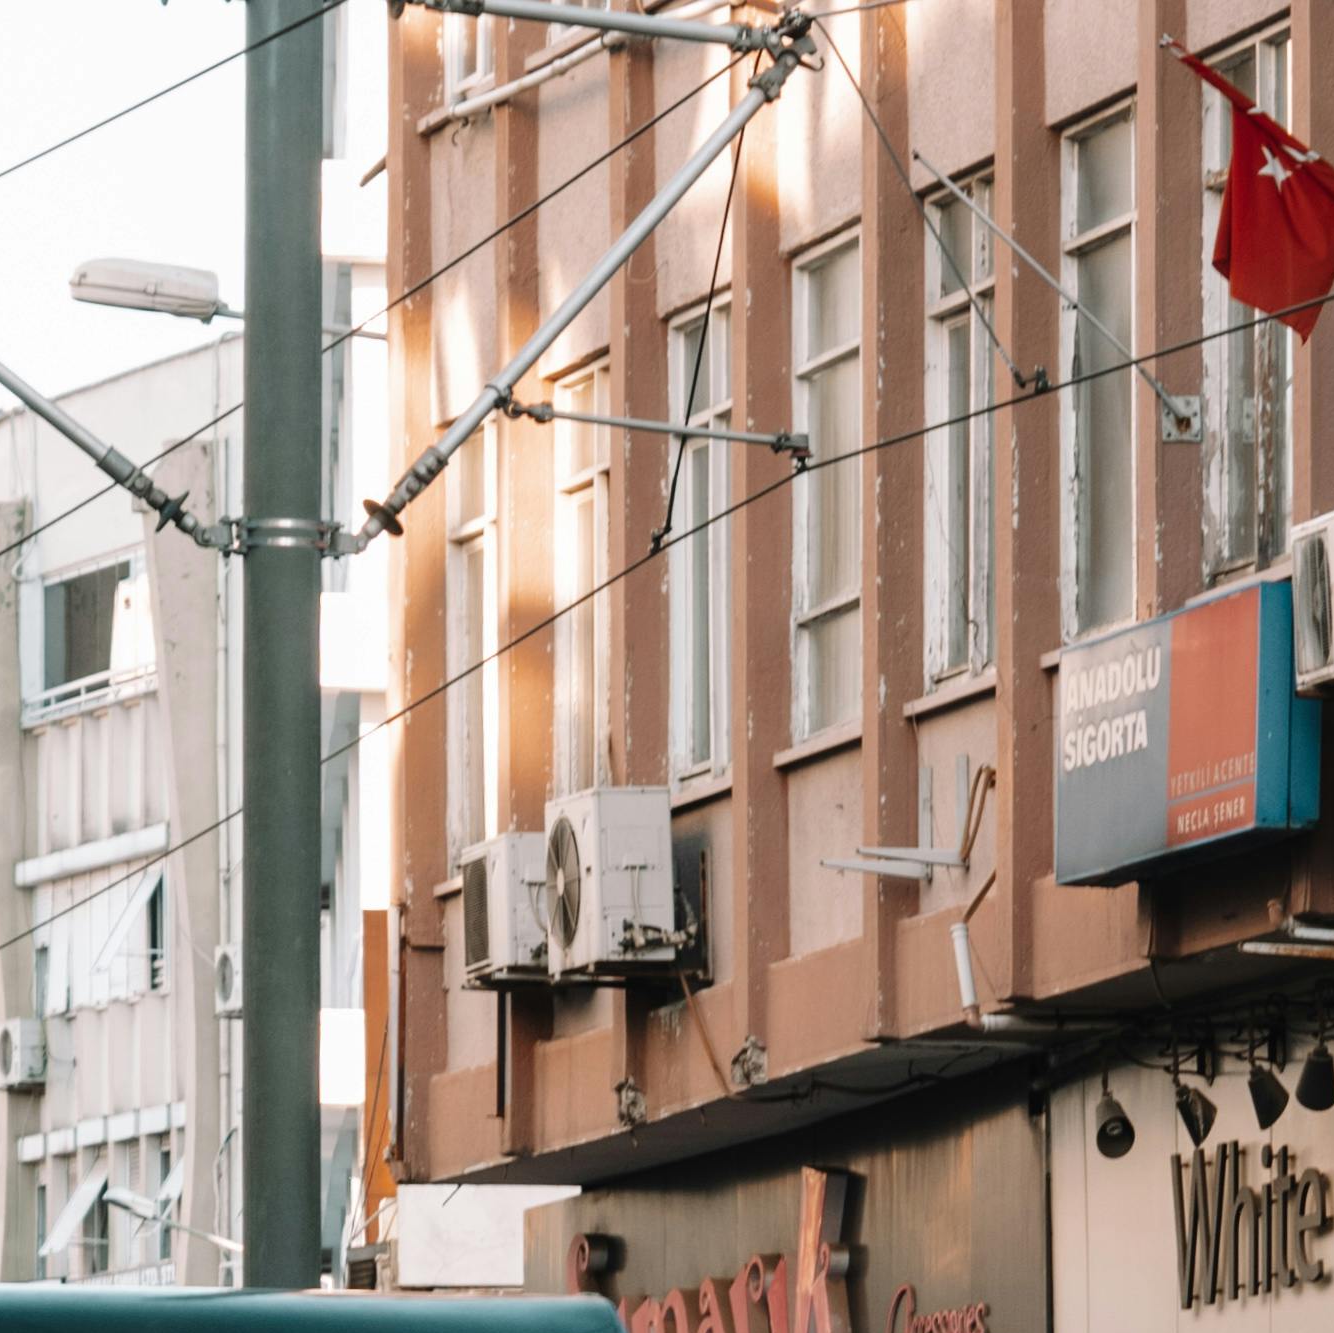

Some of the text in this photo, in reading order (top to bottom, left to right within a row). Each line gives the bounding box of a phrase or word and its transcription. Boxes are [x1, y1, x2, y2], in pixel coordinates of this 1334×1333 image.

[1066, 646, 1162, 714] ANADOLU
[1064, 710, 1148, 772] SİGORTA
[1213, 751, 1255, 785] ACENTE
[1177, 796, 1246, 834] NECLA ŞENER
[1171, 1140, 1331, 1309] White
